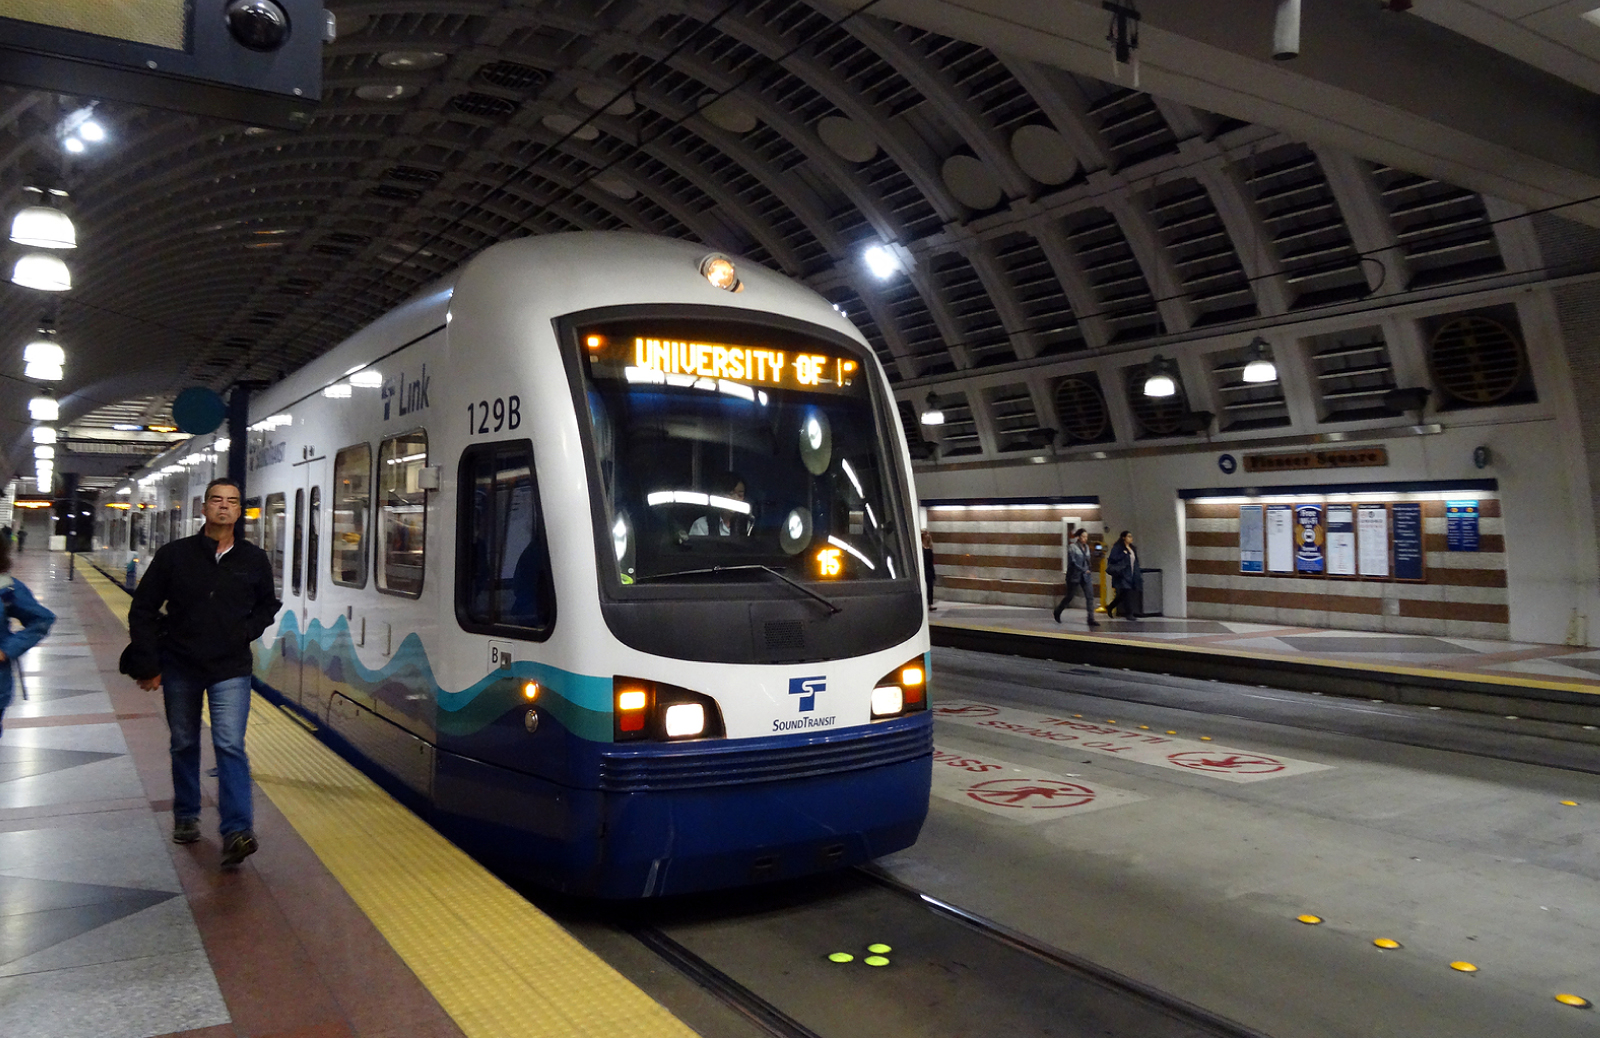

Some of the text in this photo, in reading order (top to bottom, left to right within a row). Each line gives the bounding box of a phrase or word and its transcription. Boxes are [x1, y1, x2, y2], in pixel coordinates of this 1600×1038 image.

[635, 337, 784, 382] UNIVERSITY
[796, 354, 826, 385] OF
[399, 363, 431, 417] Link
[467, 394, 521, 435] 129B
[817, 549, 841, 576] 15
[491, 646, 499, 664] B
[976, 720, 1080, 741] CROSS
[1039, 717, 1174, 744] ILLEGAL
